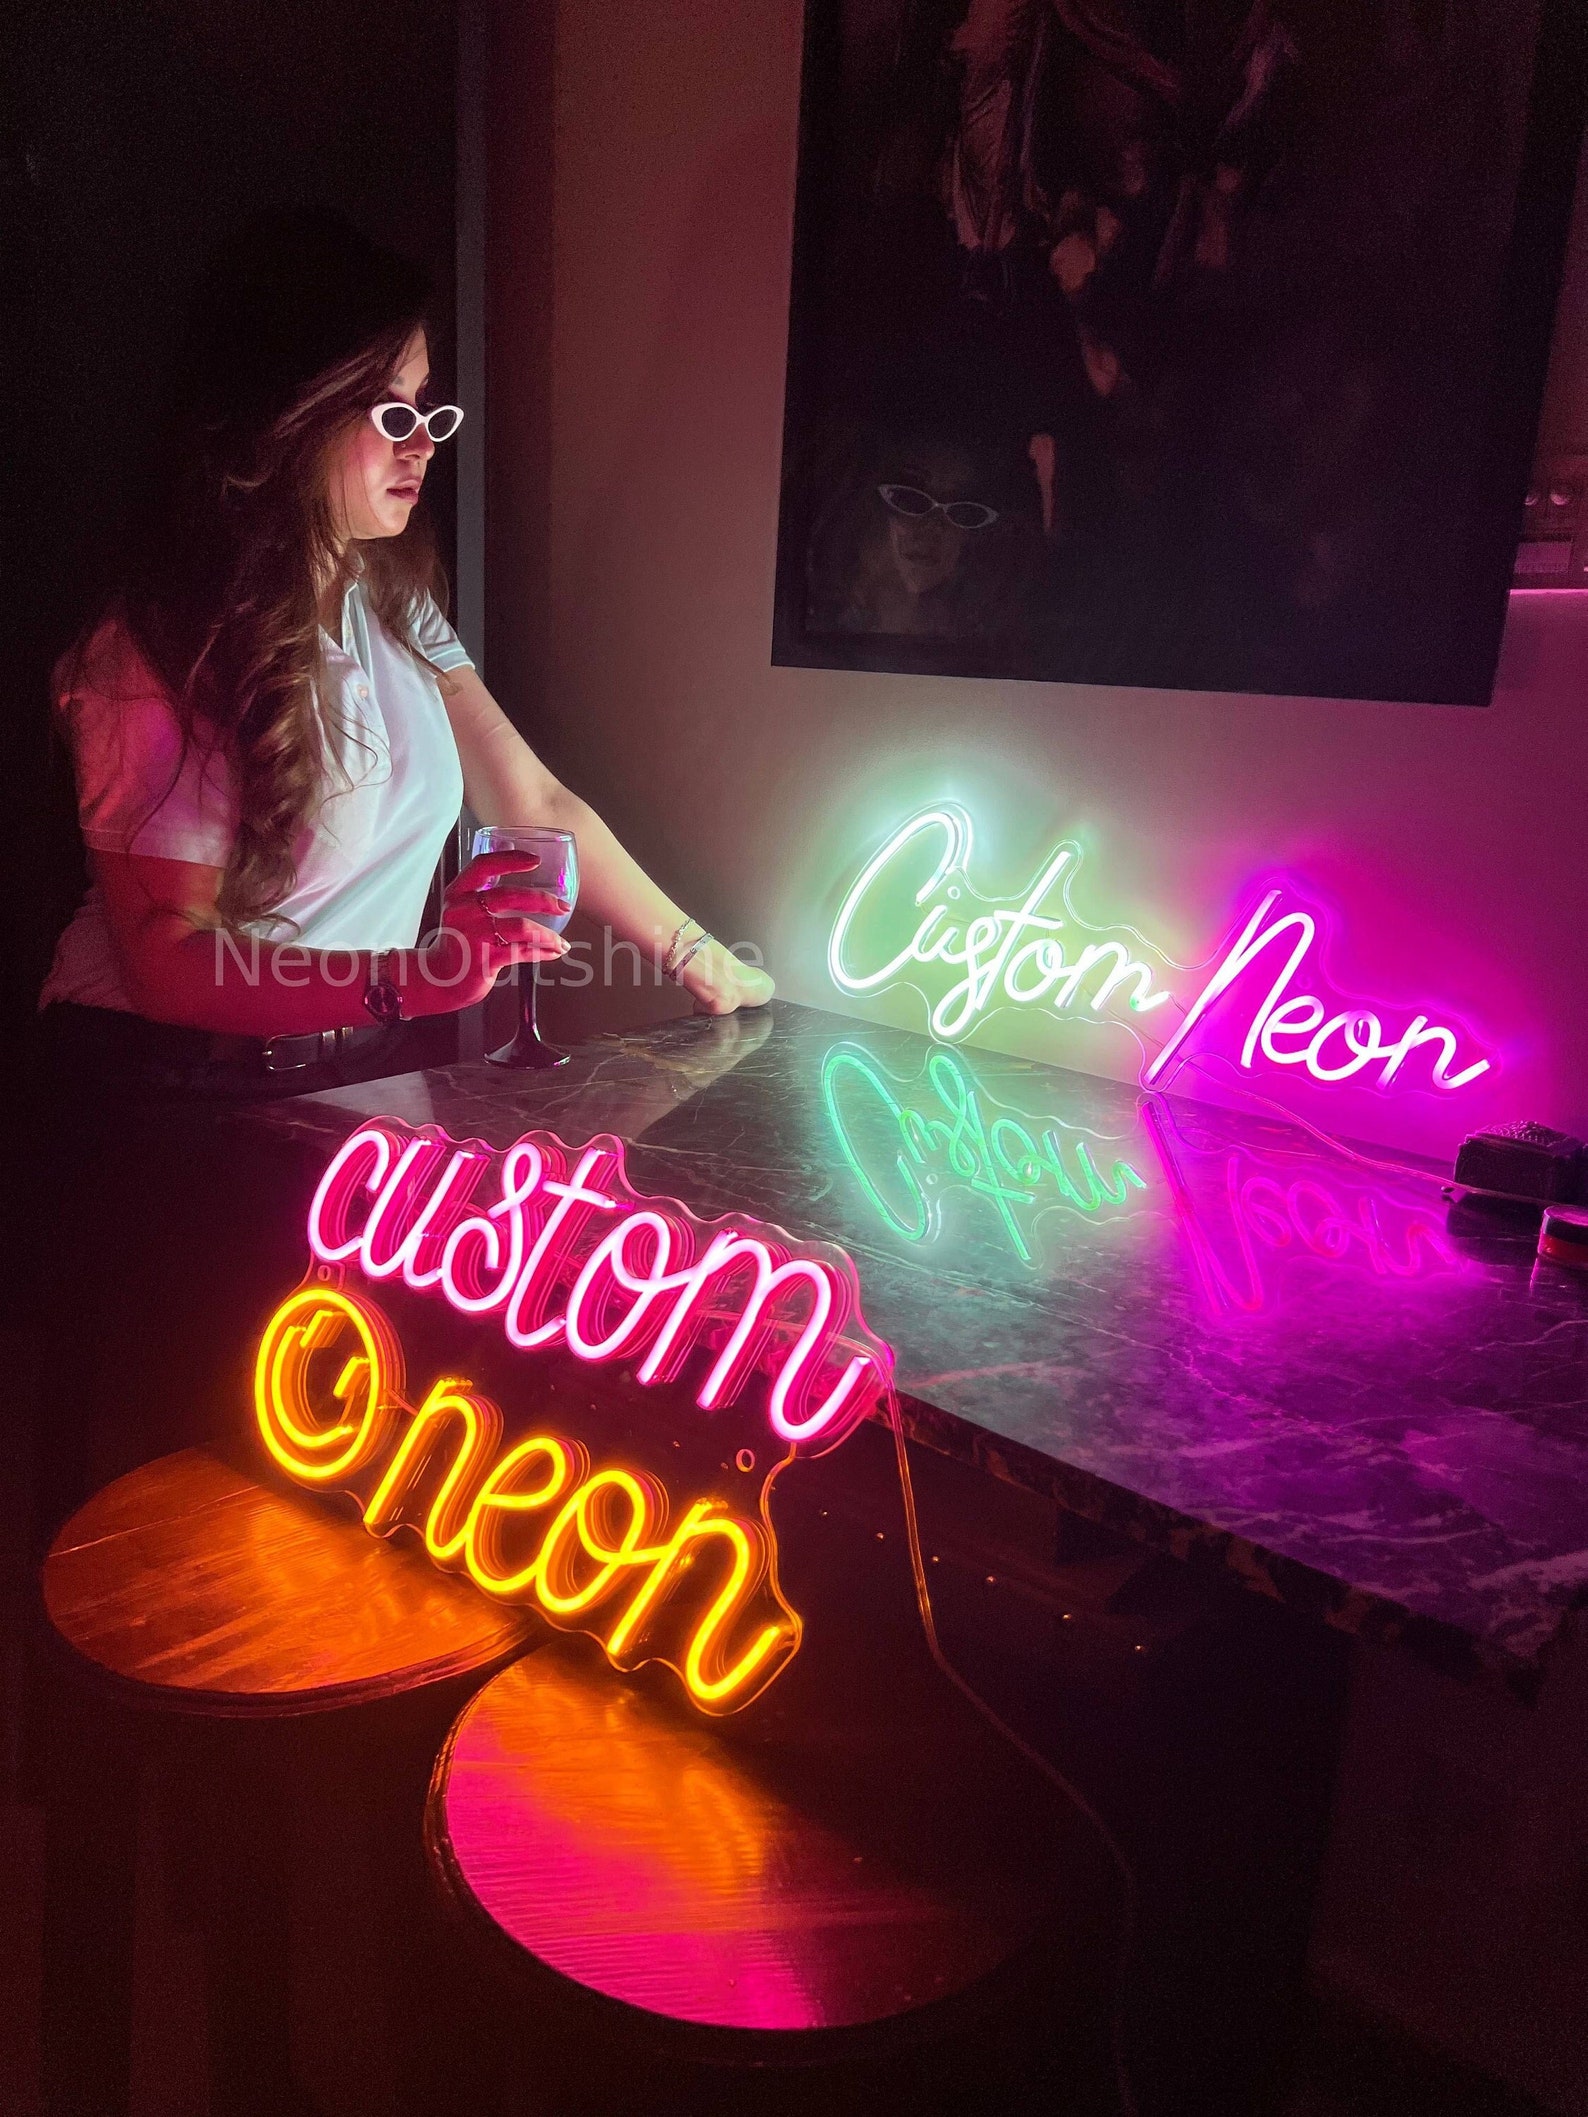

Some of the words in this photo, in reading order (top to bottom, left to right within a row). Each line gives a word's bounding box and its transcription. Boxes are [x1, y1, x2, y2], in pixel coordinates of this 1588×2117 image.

[828, 812, 1171, 1036] Custom
[1145, 889, 1491, 1090] Neon
[308, 1128, 870, 1440] custom
[362, 1377, 792, 1699] neon
